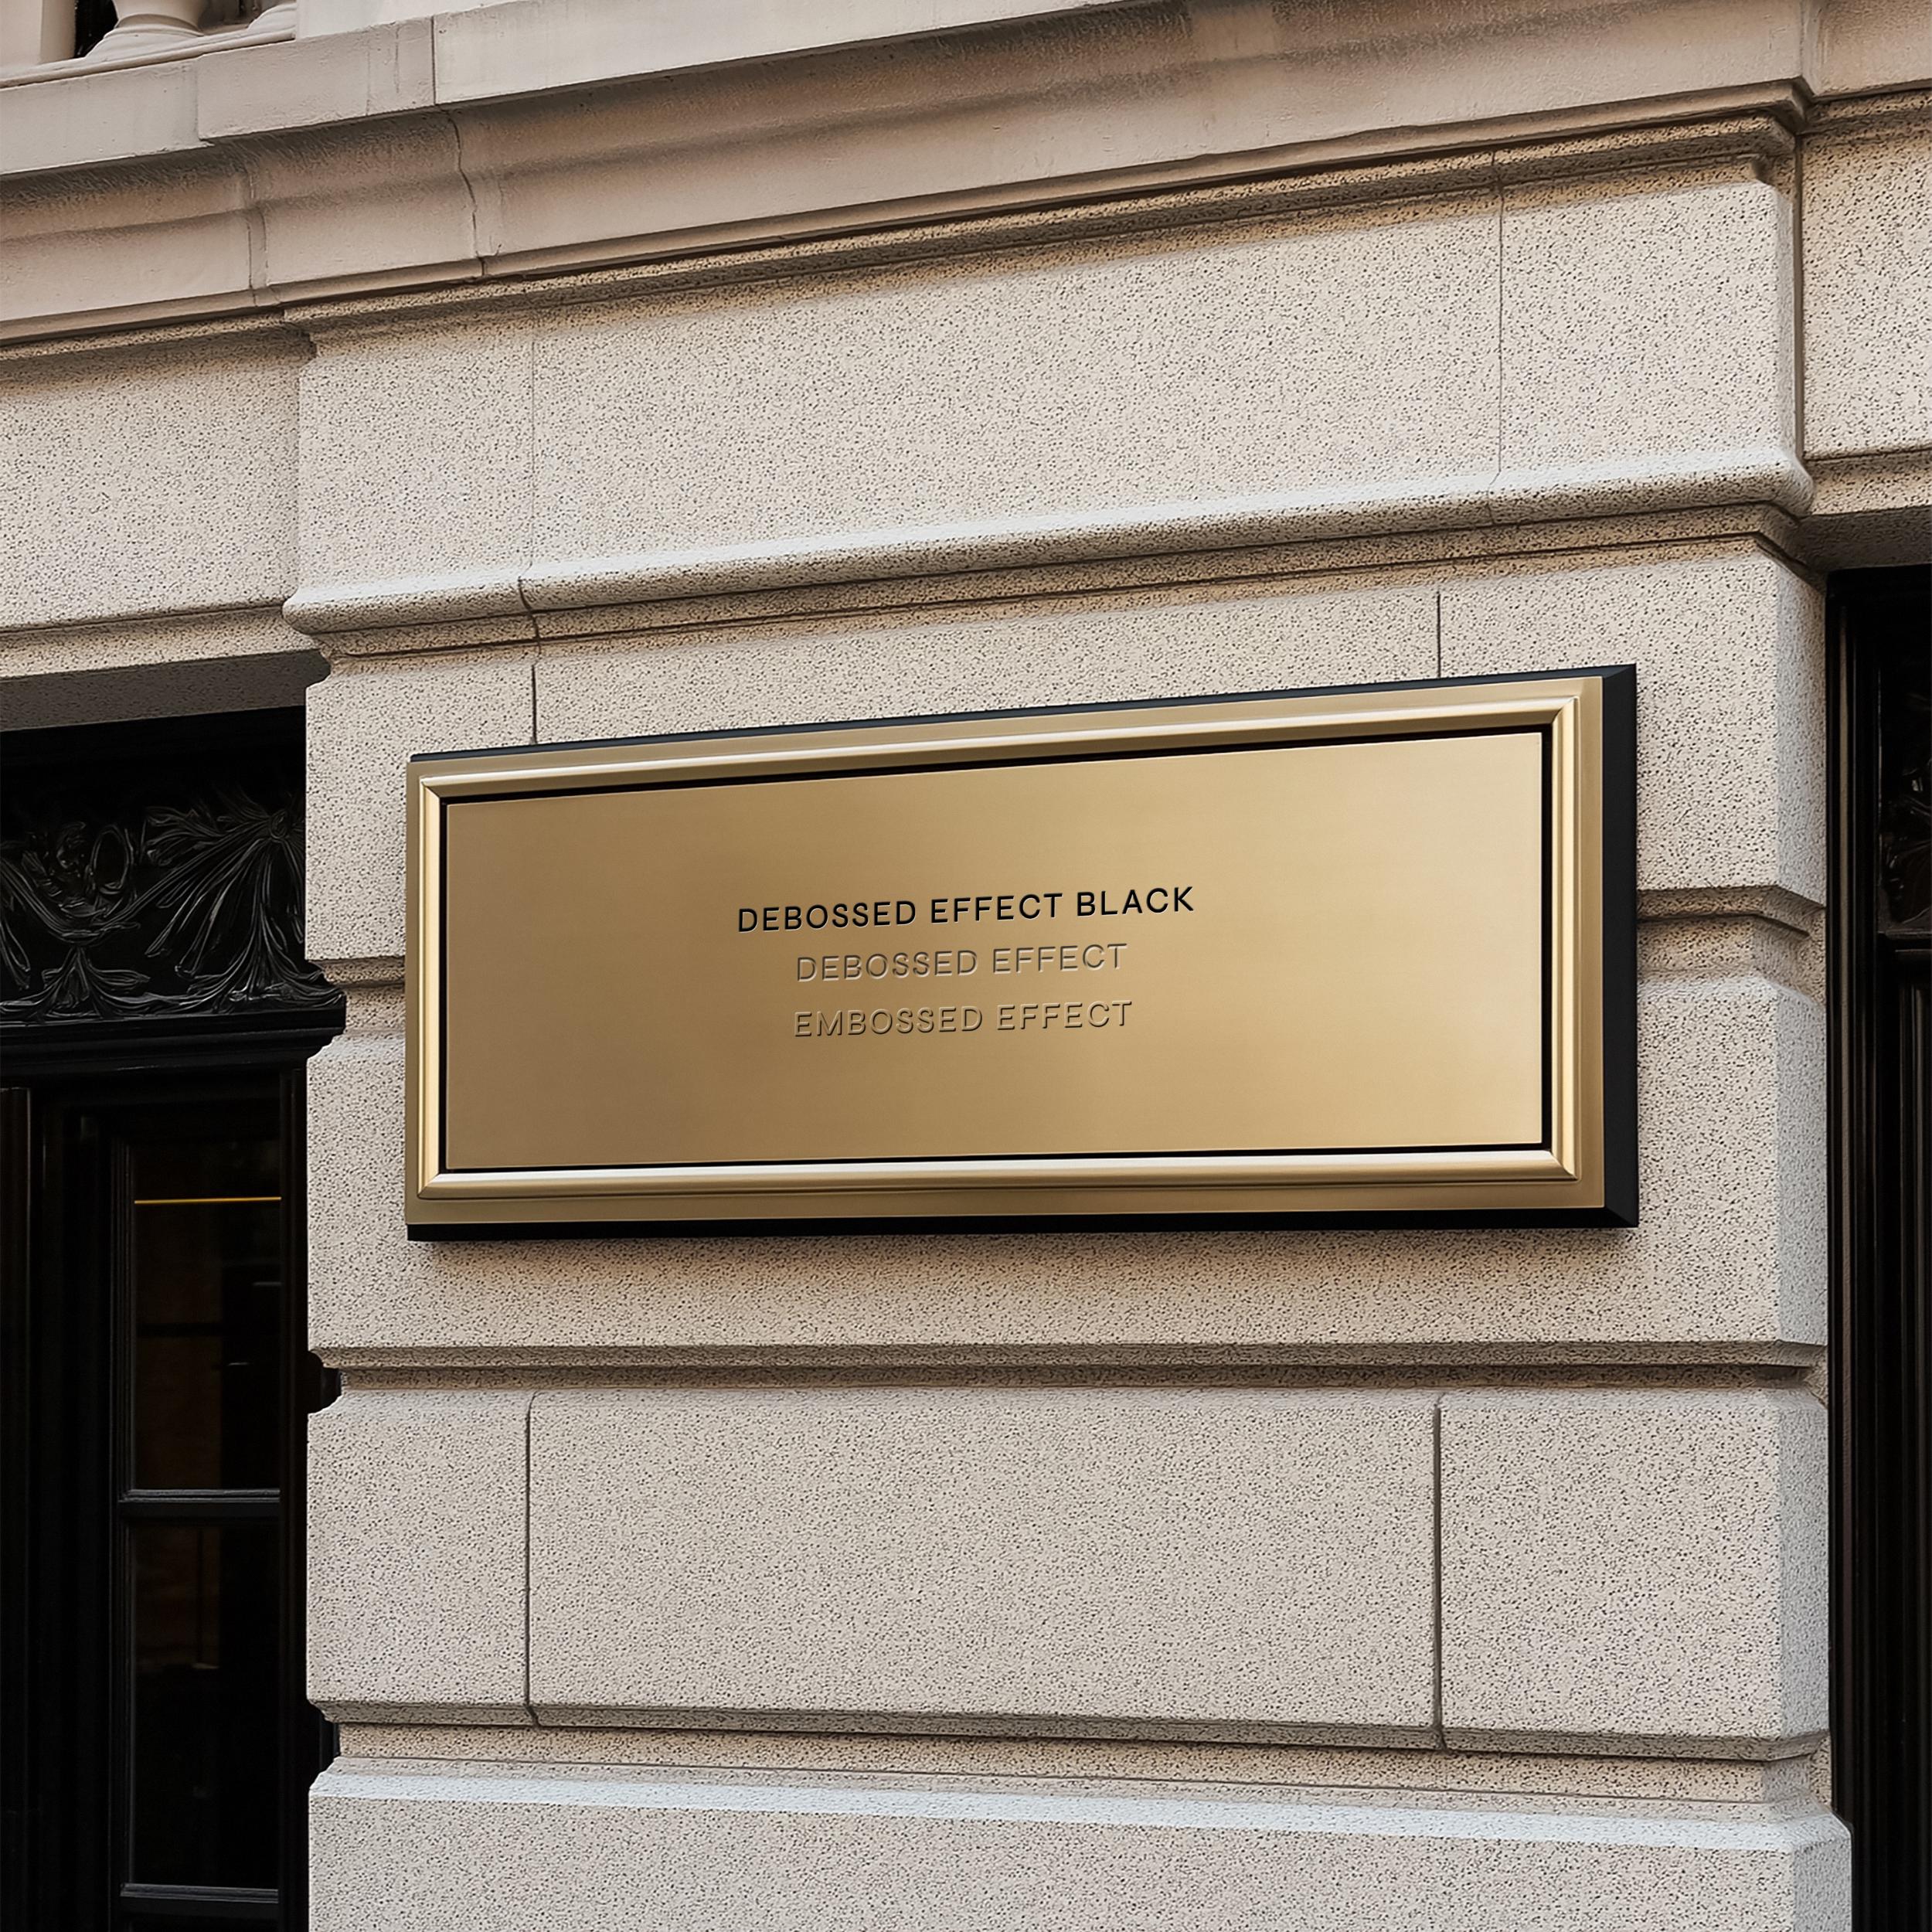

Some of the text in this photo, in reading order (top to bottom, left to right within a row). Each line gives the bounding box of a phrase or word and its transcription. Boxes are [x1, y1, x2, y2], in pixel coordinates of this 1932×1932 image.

[738, 886, 1195, 933] DEBOSSED EFFECT BLACK
[797, 944, 1128, 982] DEBOSSED EFFECT
[794, 1001, 1132, 1037] EMBOSSED EFFECT
